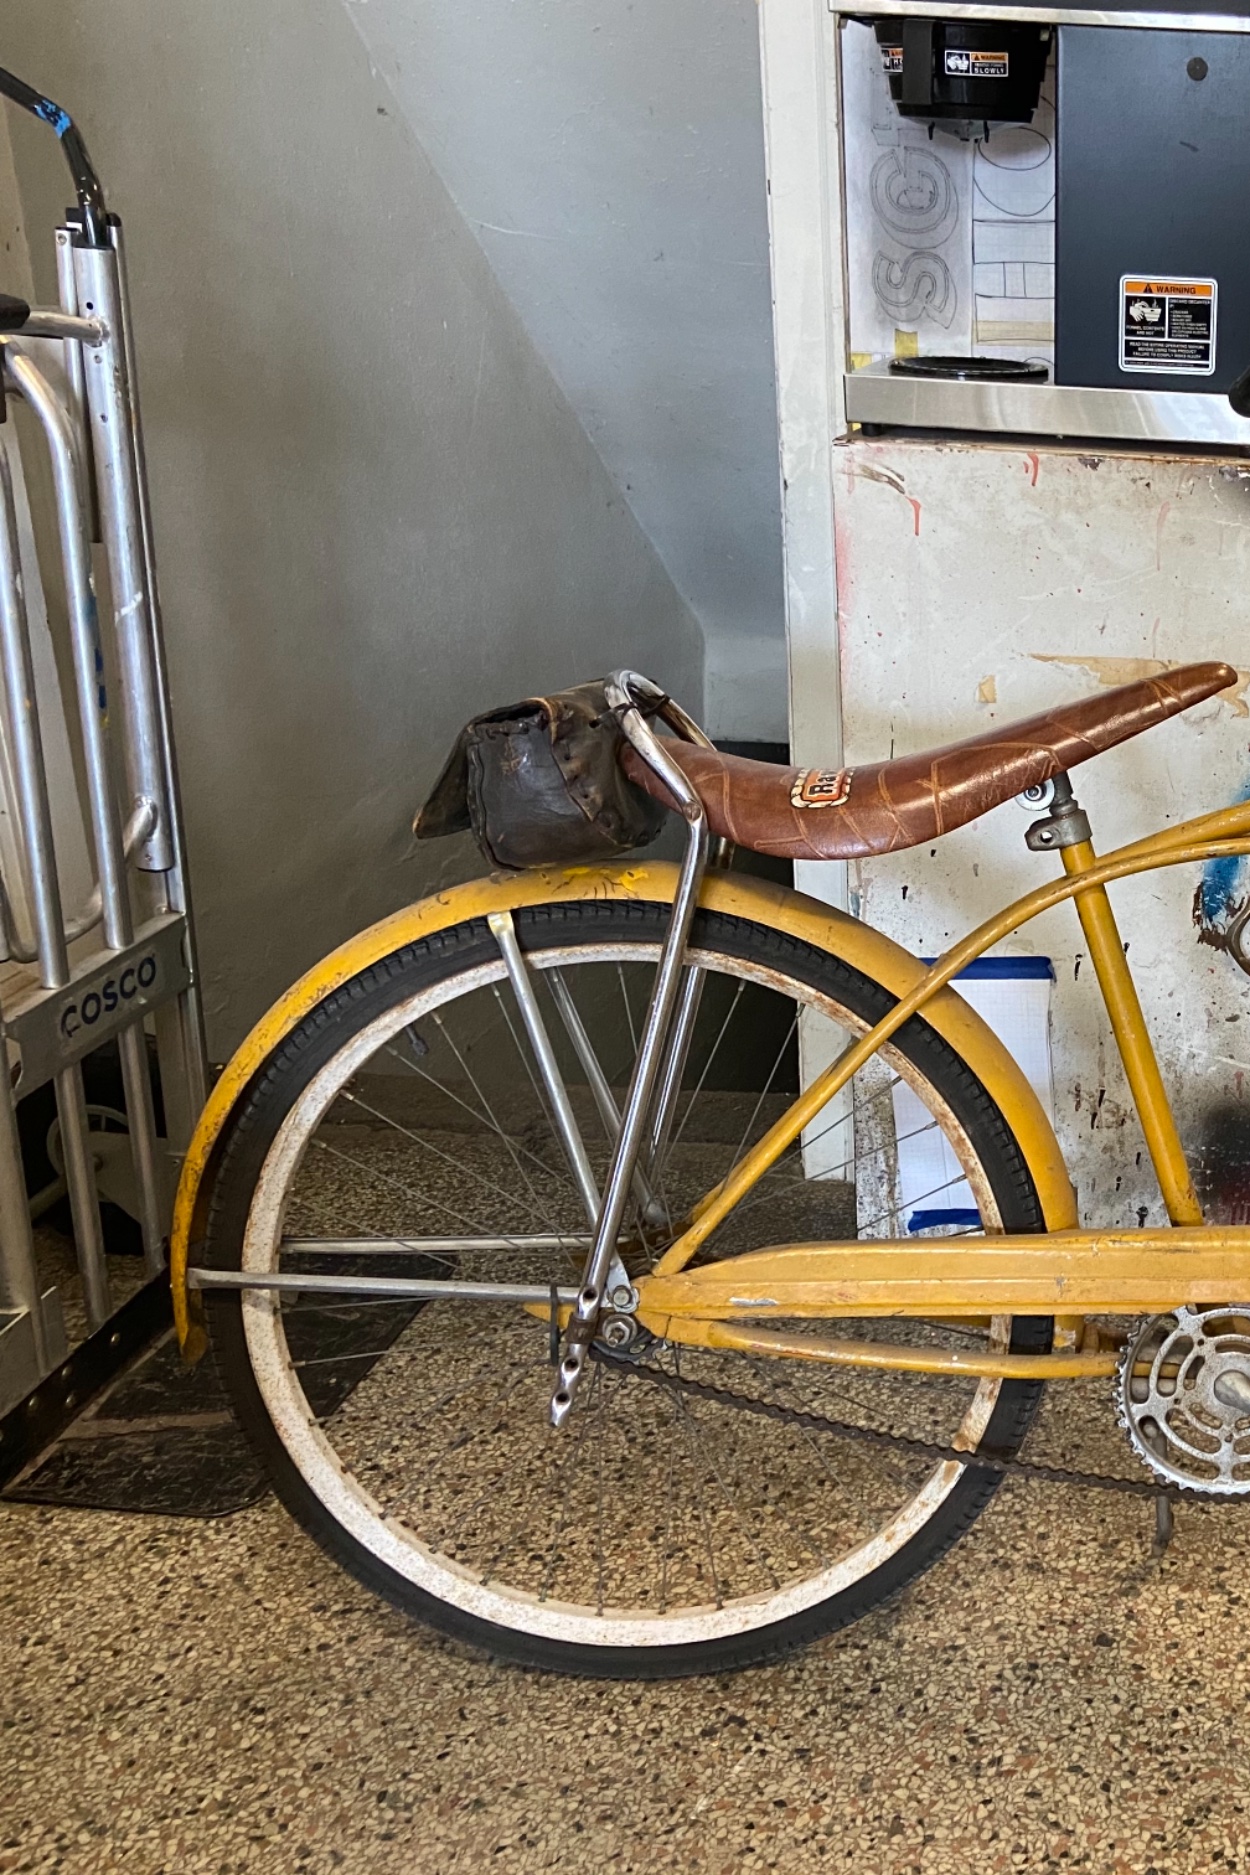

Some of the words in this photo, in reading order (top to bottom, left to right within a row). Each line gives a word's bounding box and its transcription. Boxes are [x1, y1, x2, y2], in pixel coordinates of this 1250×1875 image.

[974, 67, 1005, 75] SLOWLY
[1156, 285, 1196, 295] WARNING
[60, 956, 157, 1038] COSCO
